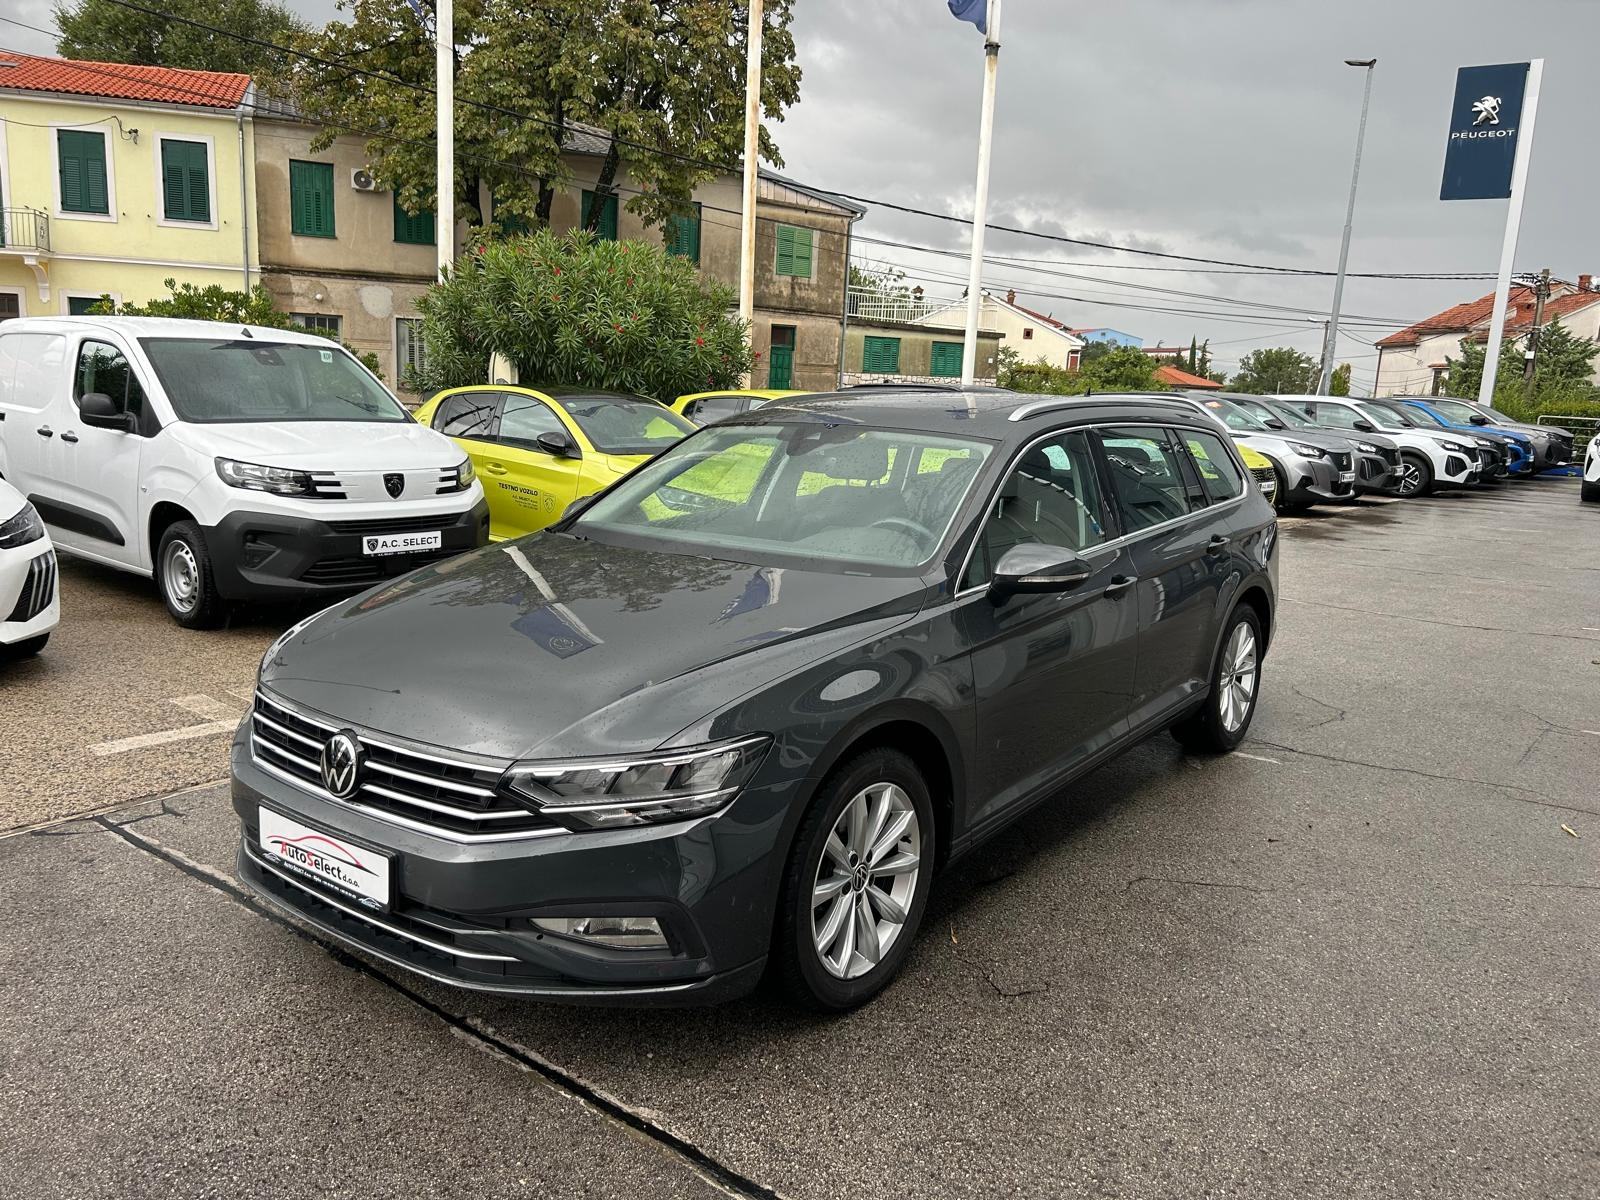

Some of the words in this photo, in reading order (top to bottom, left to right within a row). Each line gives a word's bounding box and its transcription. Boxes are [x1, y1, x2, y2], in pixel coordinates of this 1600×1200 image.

[1451, 129, 1515, 139] PEUGEOT
[498, 482, 519, 492] TESTNO
[519, 487, 539, 497] VOZILO
[381, 540, 401, 549] A.C.
[403, 536, 439, 547] SELECT
[280, 841, 342, 880] AutoSelect
[343, 875, 360, 888] d.o.o.
